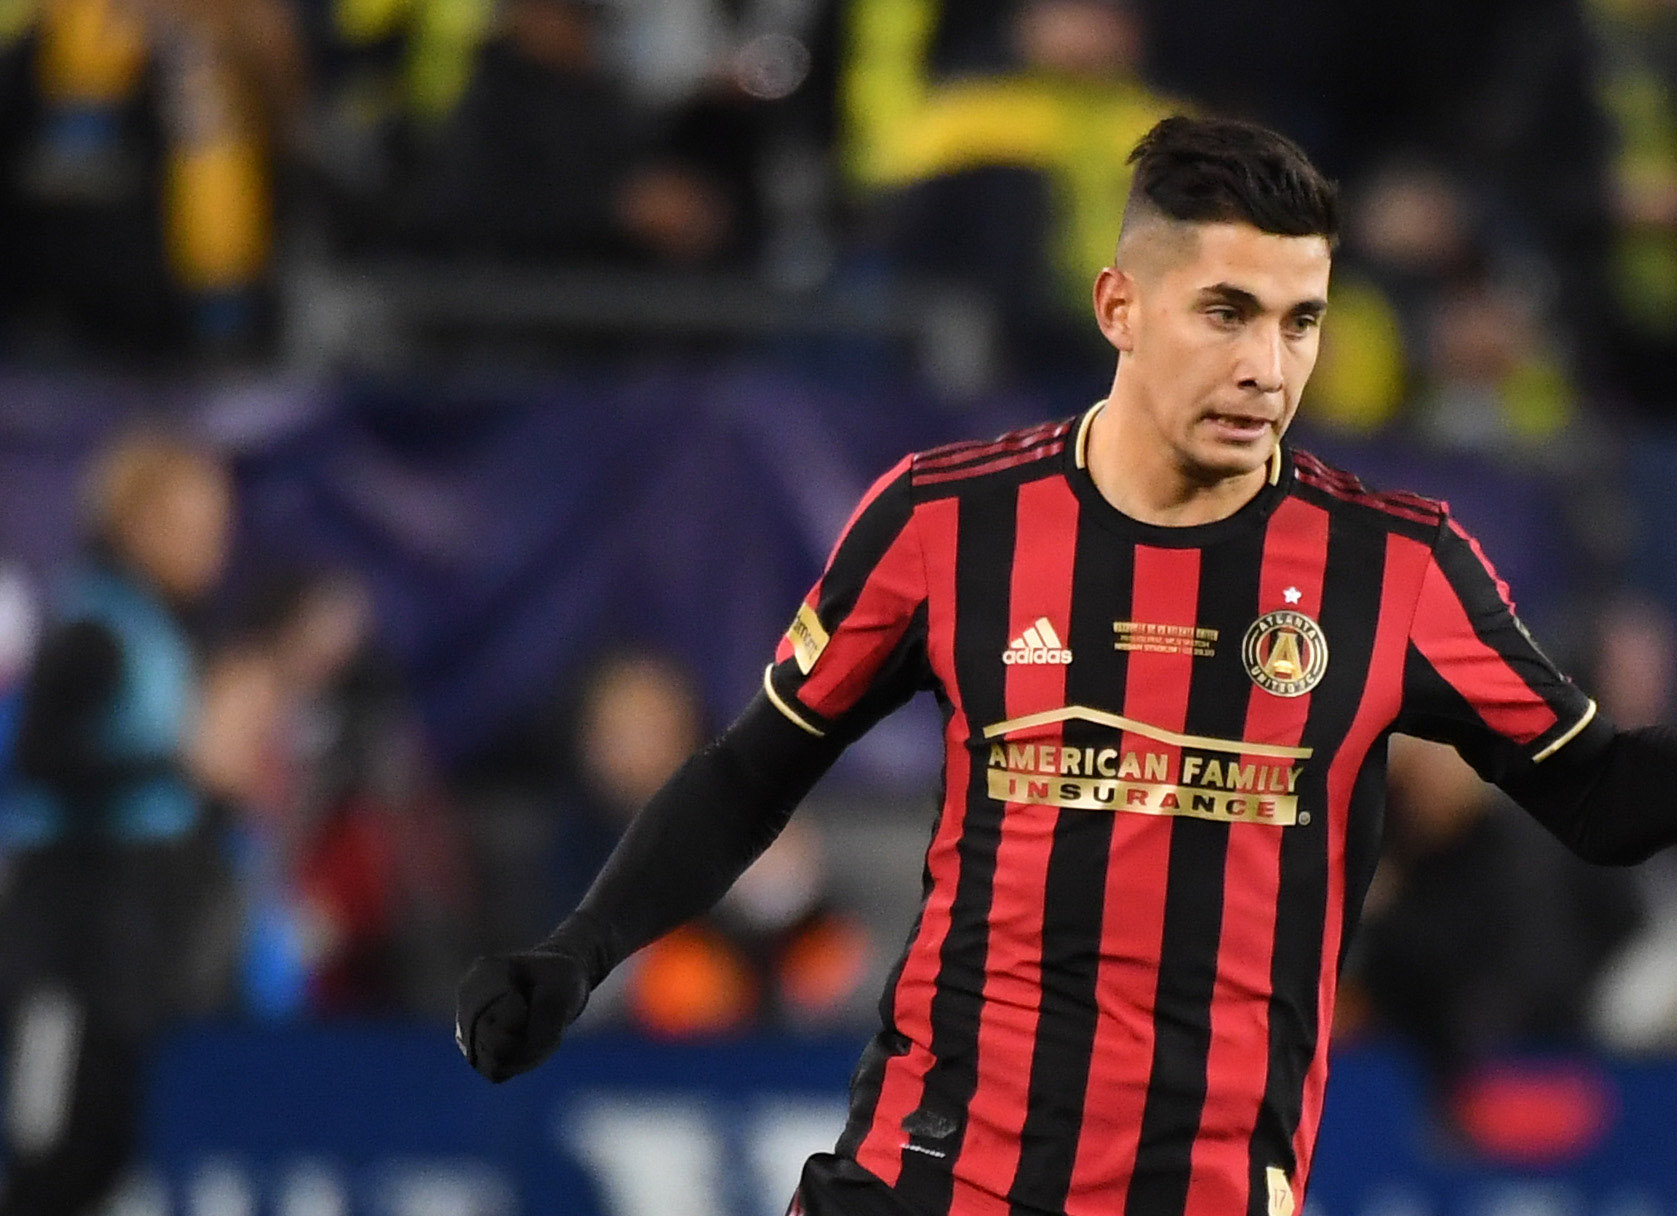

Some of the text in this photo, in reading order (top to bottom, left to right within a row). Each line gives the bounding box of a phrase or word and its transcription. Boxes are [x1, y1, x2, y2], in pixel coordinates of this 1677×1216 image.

[1258, 612, 1318, 641] ATLANTA
[1002, 646, 1073, 665] adidas
[1264, 632, 1304, 680] A
[1250, 665, 1296, 694] UNITED
[988, 742, 1305, 795] AMERICAN FAMILY
[1008, 778, 1277, 819] INSURANCE
